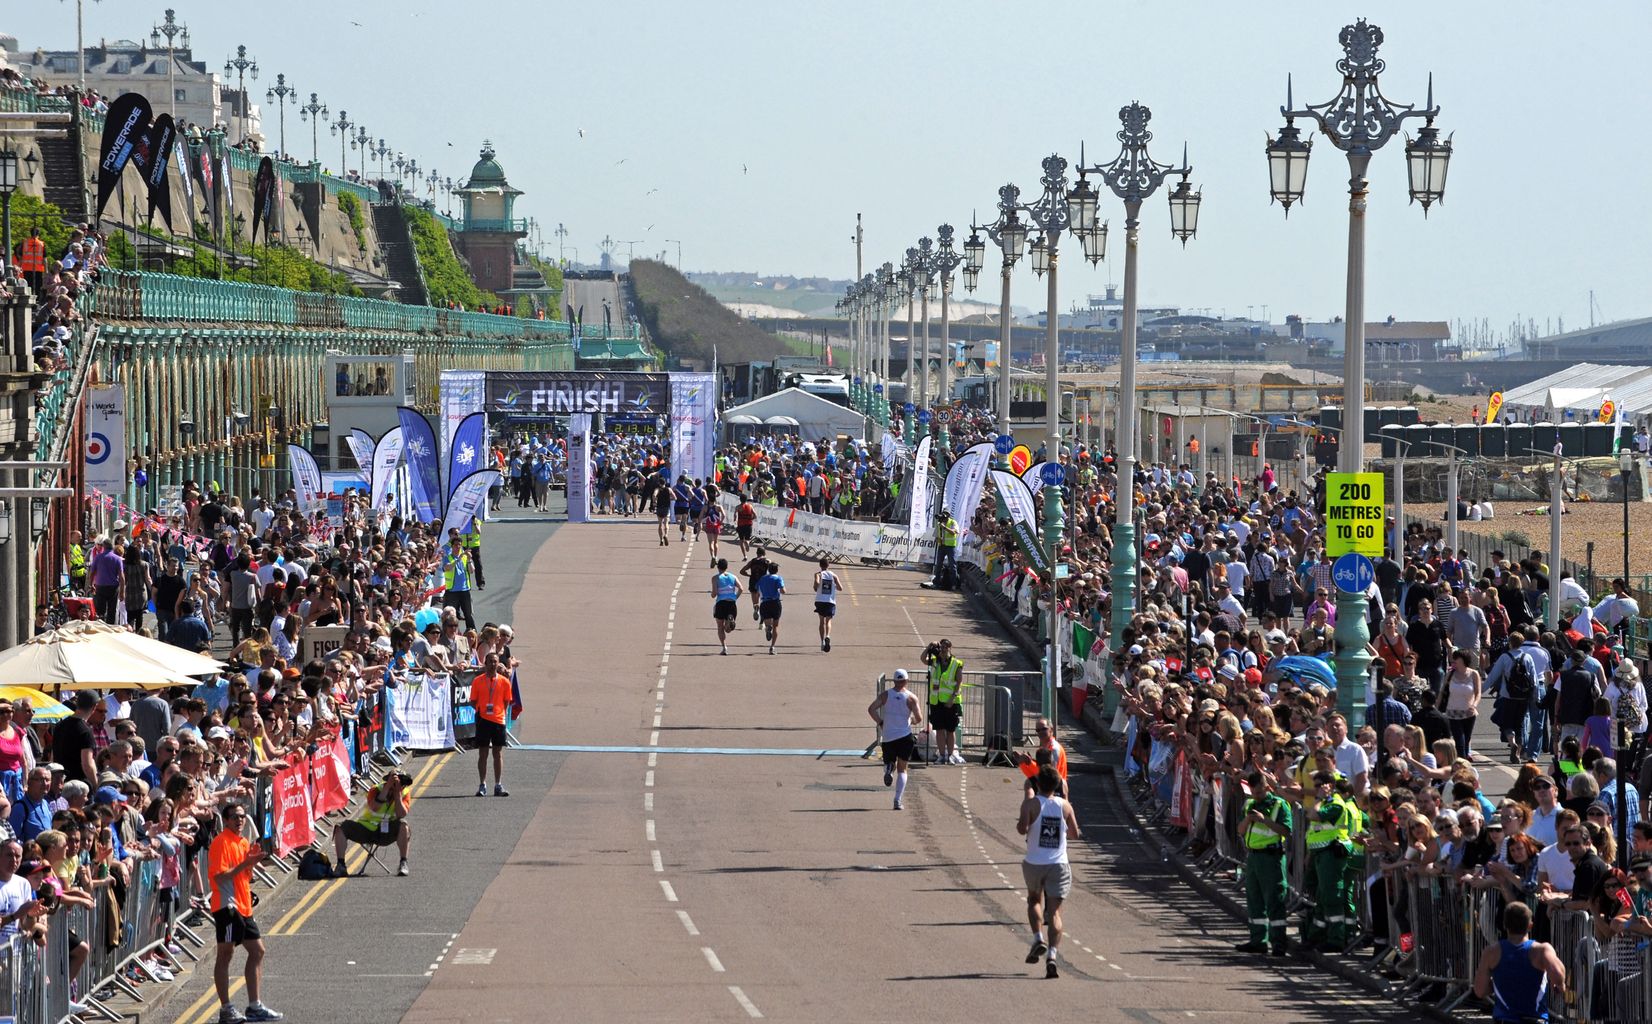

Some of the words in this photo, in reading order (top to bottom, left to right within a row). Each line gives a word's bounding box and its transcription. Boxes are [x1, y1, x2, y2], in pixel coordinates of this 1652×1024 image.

[102, 106, 142, 171] POWERADE
[150, 126, 171, 185] POWERADE
[531, 389, 619, 413] FINISH
[939, 411, 949, 420] 30
[1340, 483, 1371, 500] 200
[1330, 506, 1382, 520] METRES
[1336, 525, 1352, 539] TO
[1356, 525, 1374, 539] GO
[881, 534, 912, 547] Brighton
[913, 537, 937, 549] Mara
[1015, 524, 1047, 570] GREENPEACE
